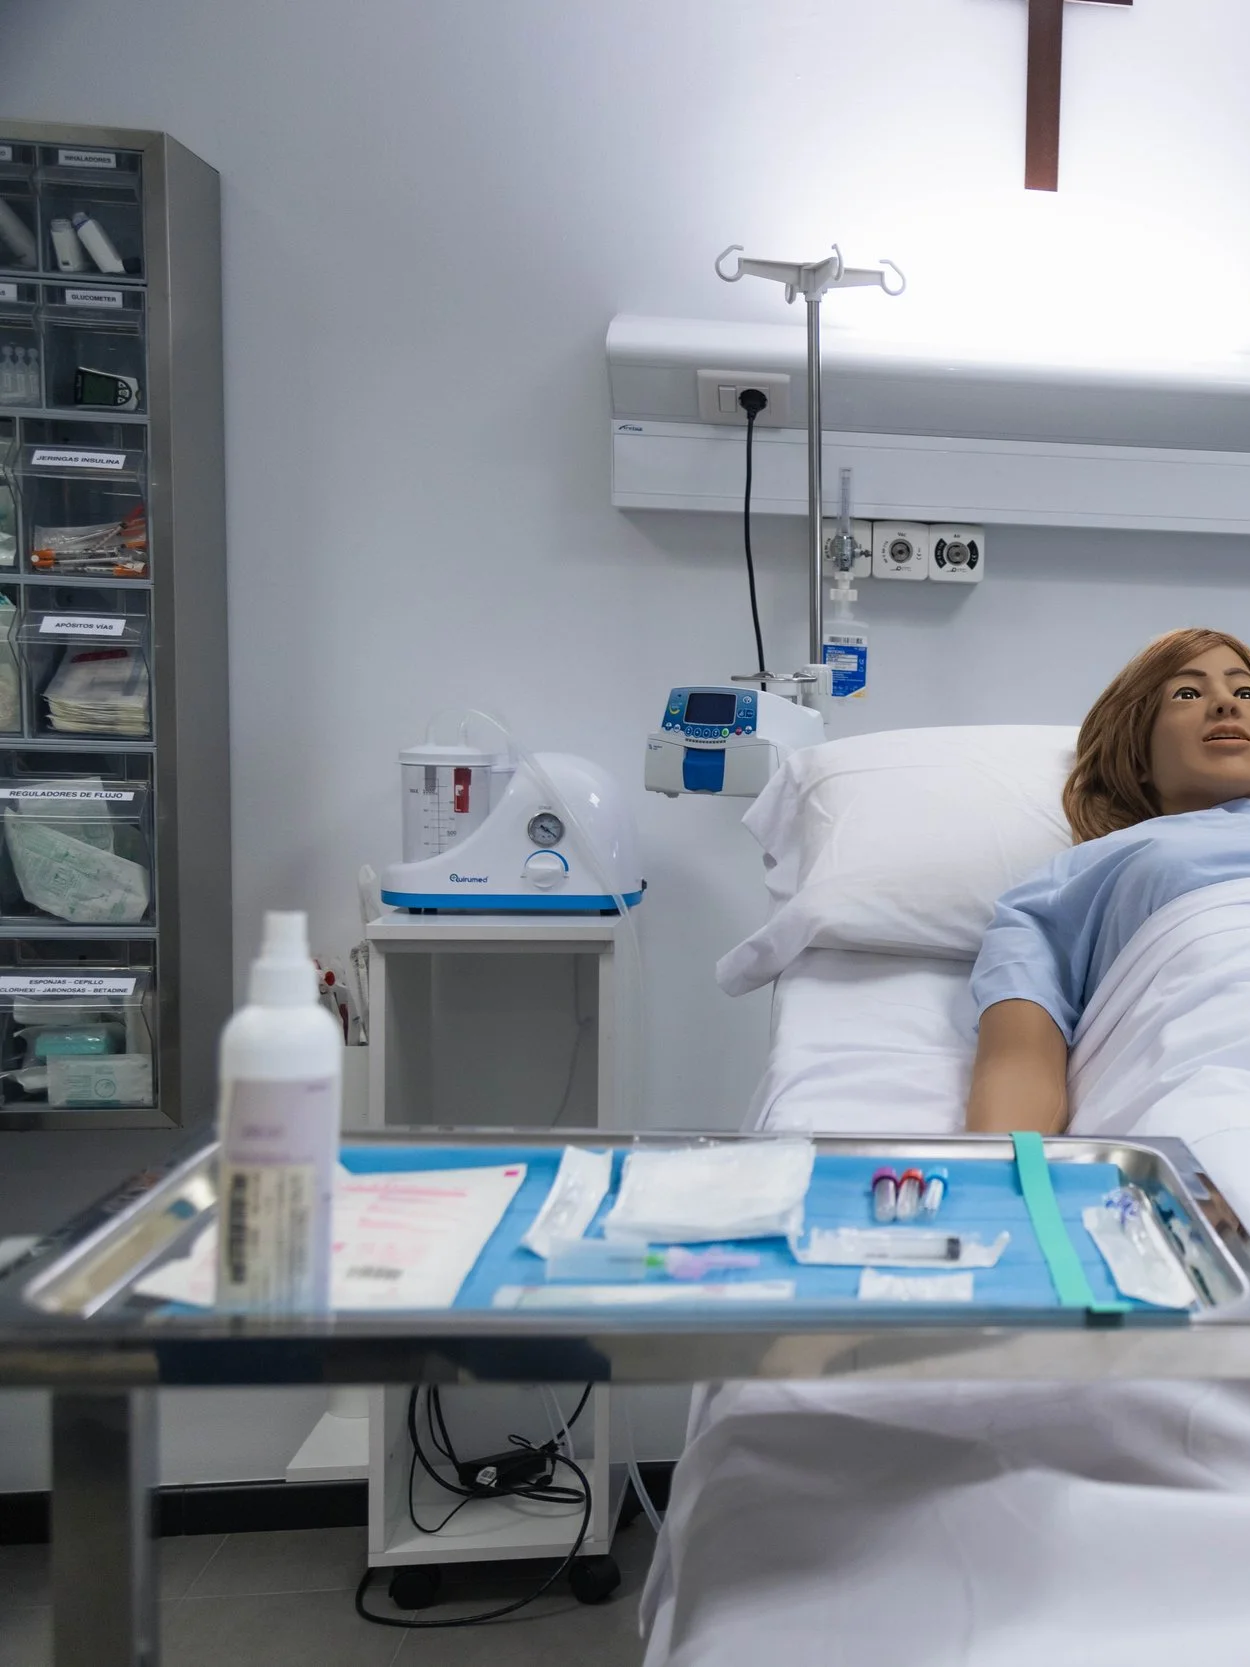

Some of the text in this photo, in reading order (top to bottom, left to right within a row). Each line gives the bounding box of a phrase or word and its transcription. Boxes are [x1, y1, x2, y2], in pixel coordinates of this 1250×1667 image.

[71, 294, 117, 302] GLUCOMETER
[36, 455, 80, 463] JERINGAS
[55, 621, 94, 629] APÓSITOS
